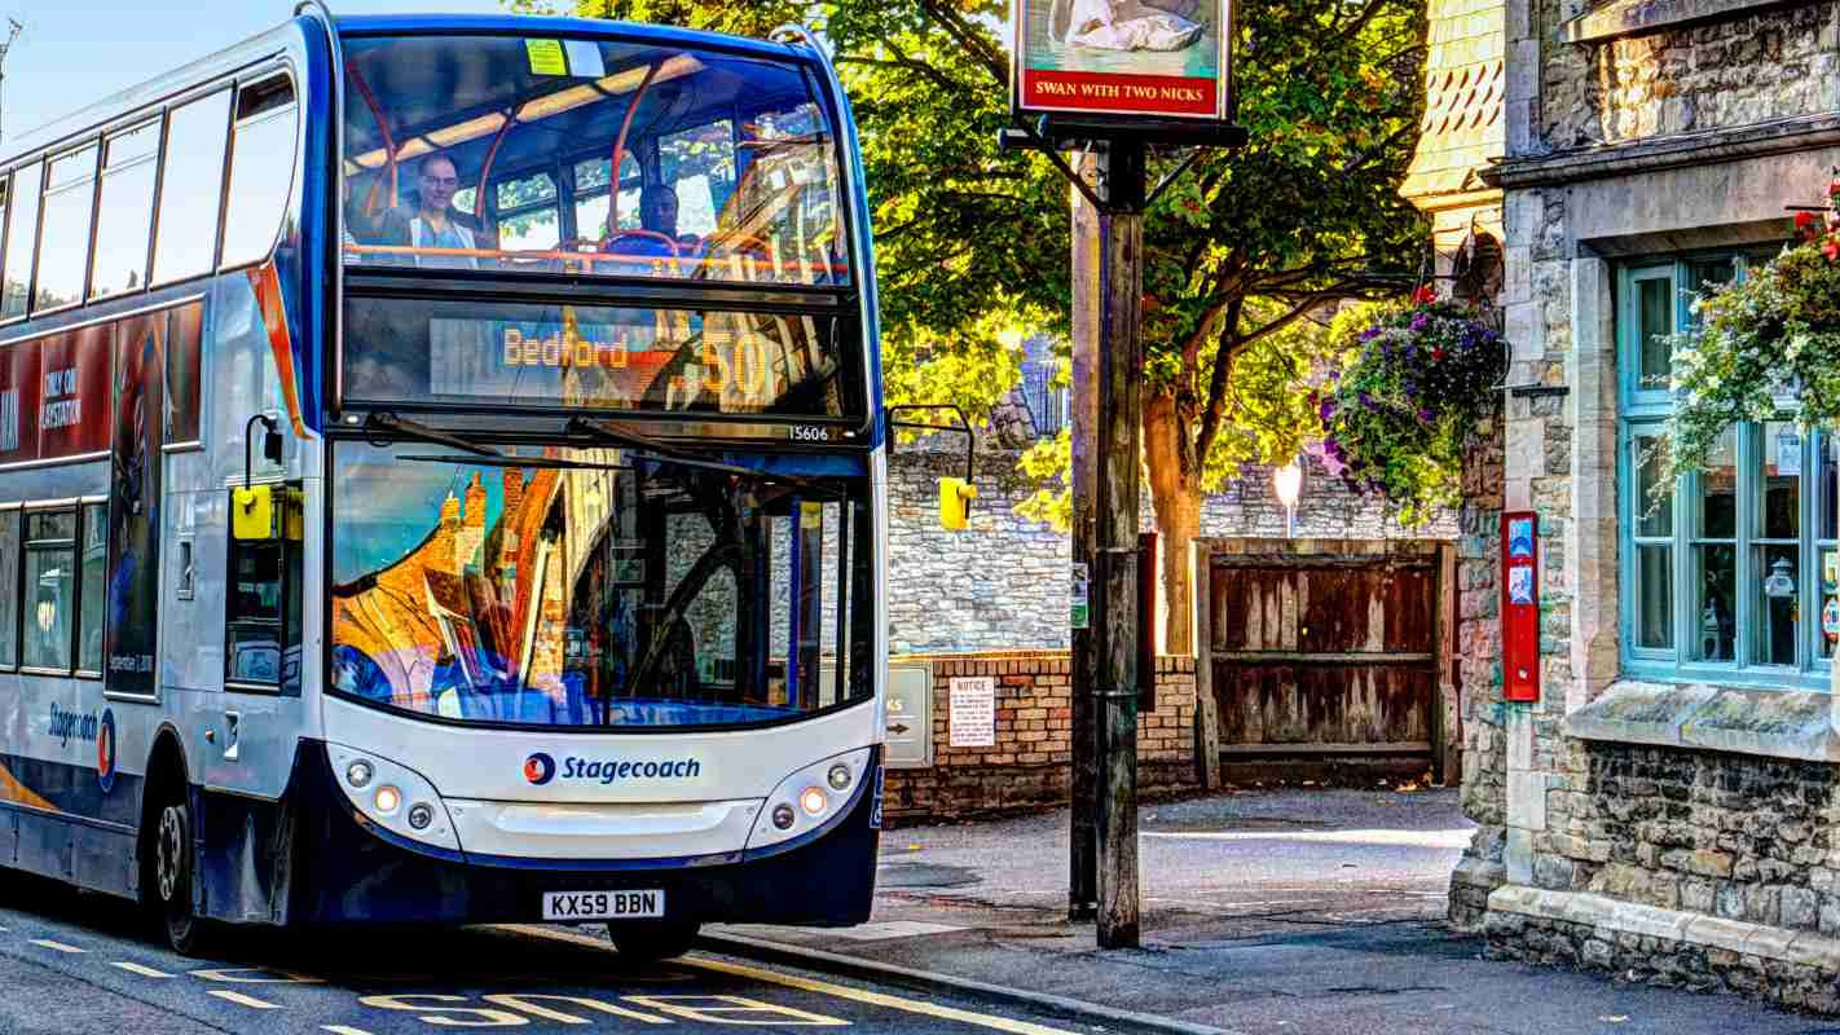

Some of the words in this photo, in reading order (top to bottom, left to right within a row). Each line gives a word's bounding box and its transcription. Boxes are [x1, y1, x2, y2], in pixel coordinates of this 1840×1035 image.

[1036, 81, 1077, 96] SWAN
[1080, 83, 1119, 99] WITH
[1123, 85, 1157, 99] TWO
[1160, 86, 1204, 101] NICKS
[504, 328, 628, 369] Bedford
[699, 330, 767, 394] 50
[789, 425, 829, 441] 15606
[956, 680, 988, 692] NOTICE
[48, 701, 98, 752] Stagecoach
[562, 755, 701, 785] Stagecoach
[551, 894, 608, 916] KX59
[614, 892, 656, 914] BBN
